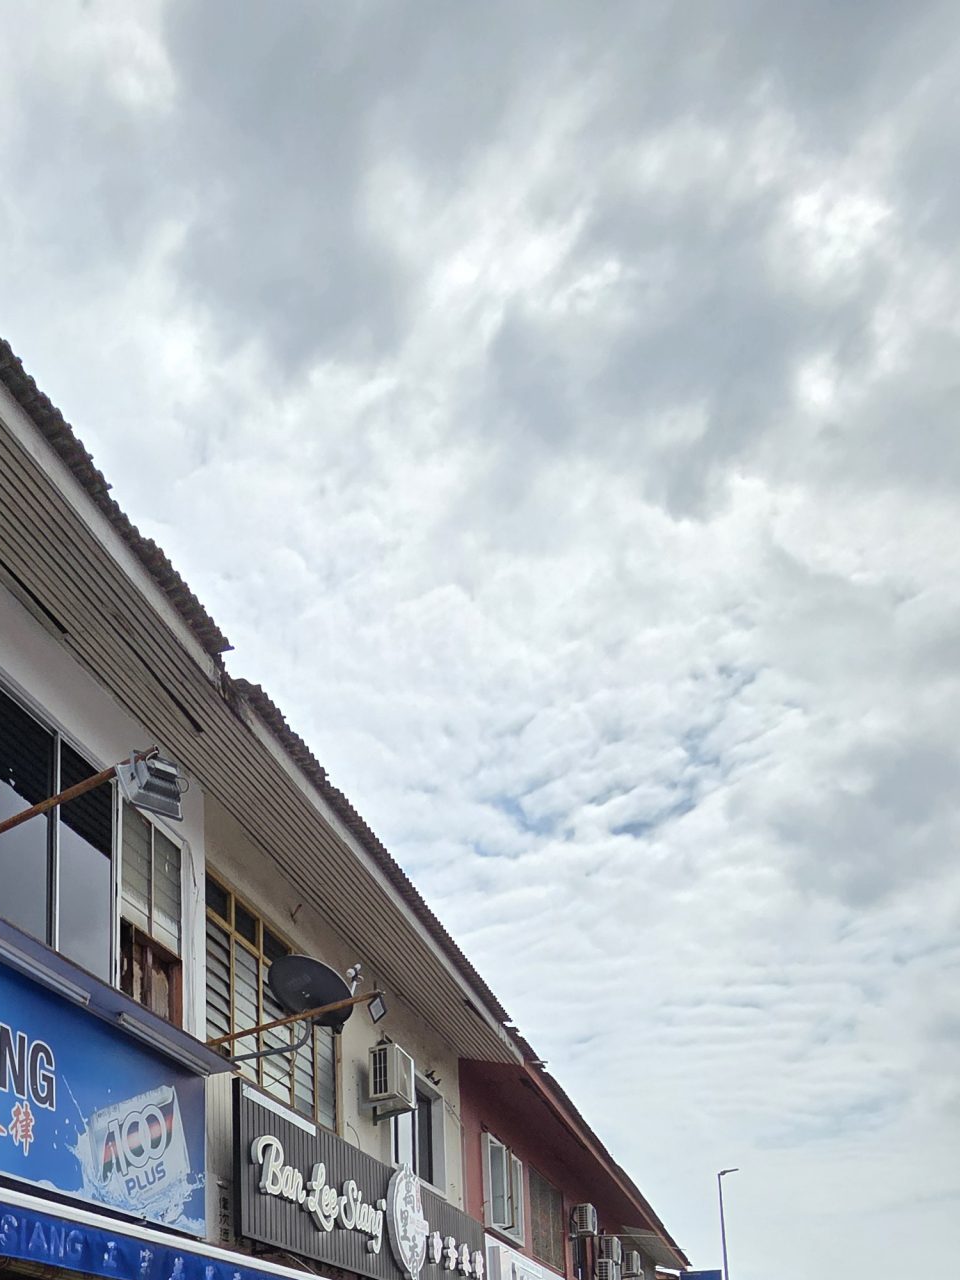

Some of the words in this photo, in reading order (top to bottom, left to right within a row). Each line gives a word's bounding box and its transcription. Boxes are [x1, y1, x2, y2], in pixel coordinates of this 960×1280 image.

[108, 1104, 167, 1177] 100
[125, 1161, 166, 1195] PLUS
[251, 1135, 306, 1204] Ban
[304, 1162, 339, 1232] Lee
[337, 1180, 387, 1254] Siang
[0, 1214, 83, 1259] SIANG
